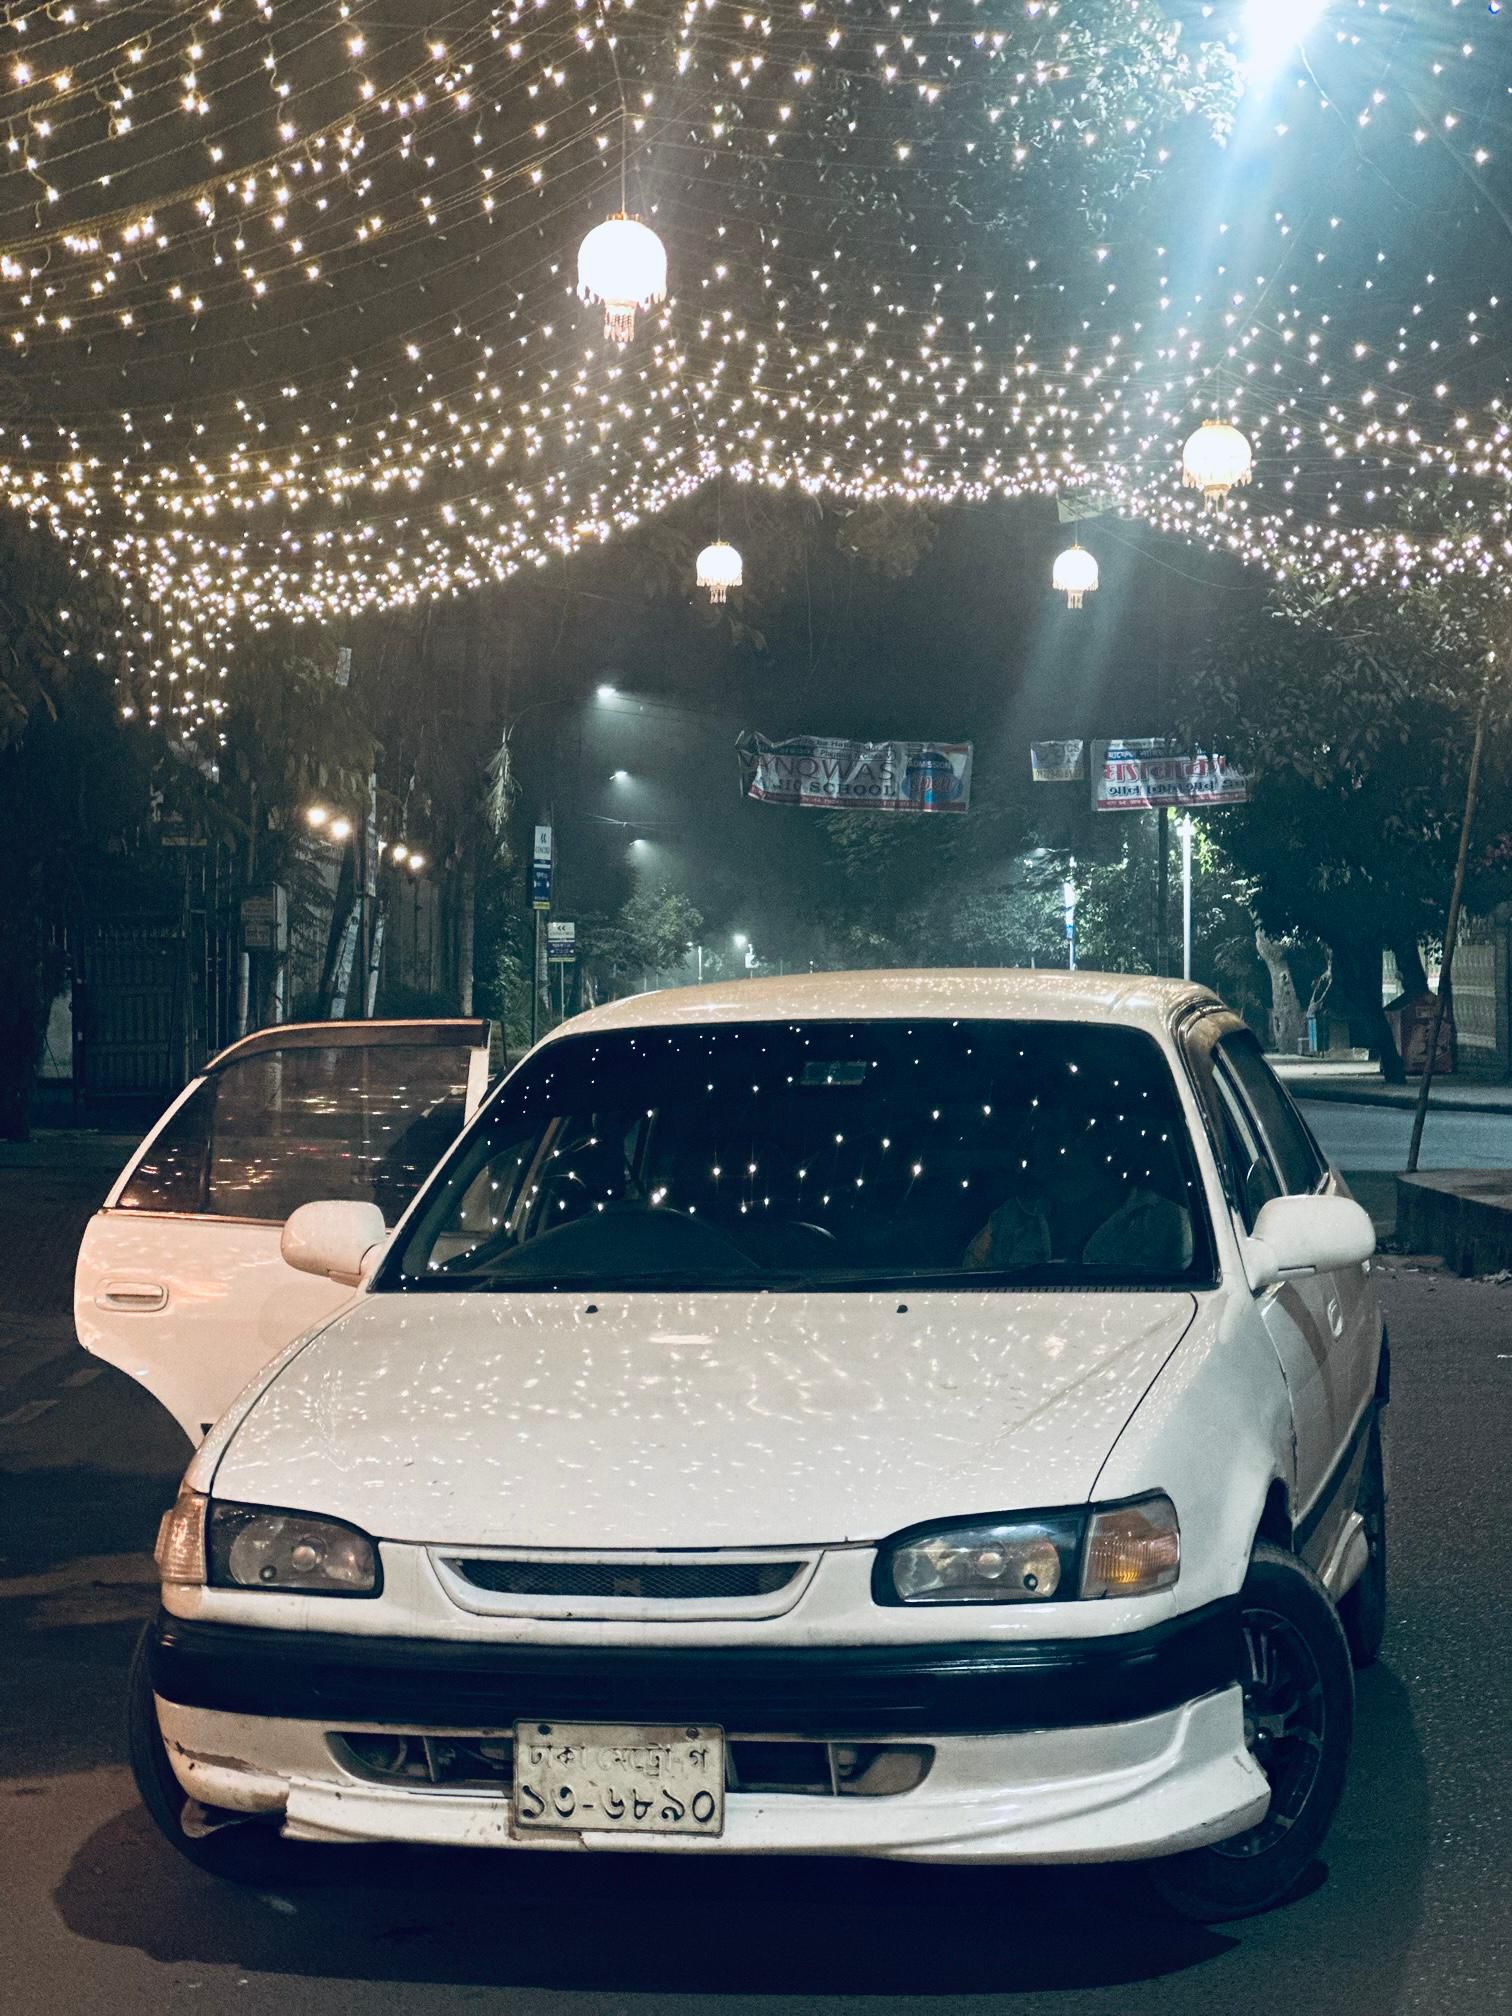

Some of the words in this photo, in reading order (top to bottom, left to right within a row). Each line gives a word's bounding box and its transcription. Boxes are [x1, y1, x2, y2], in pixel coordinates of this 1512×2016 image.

[809, 780, 896, 797] SCHOOL
[529, 1744, 587, 1771] ঢাকা
[521, 1784, 716, 1824] ১৩-৬৮৯০
